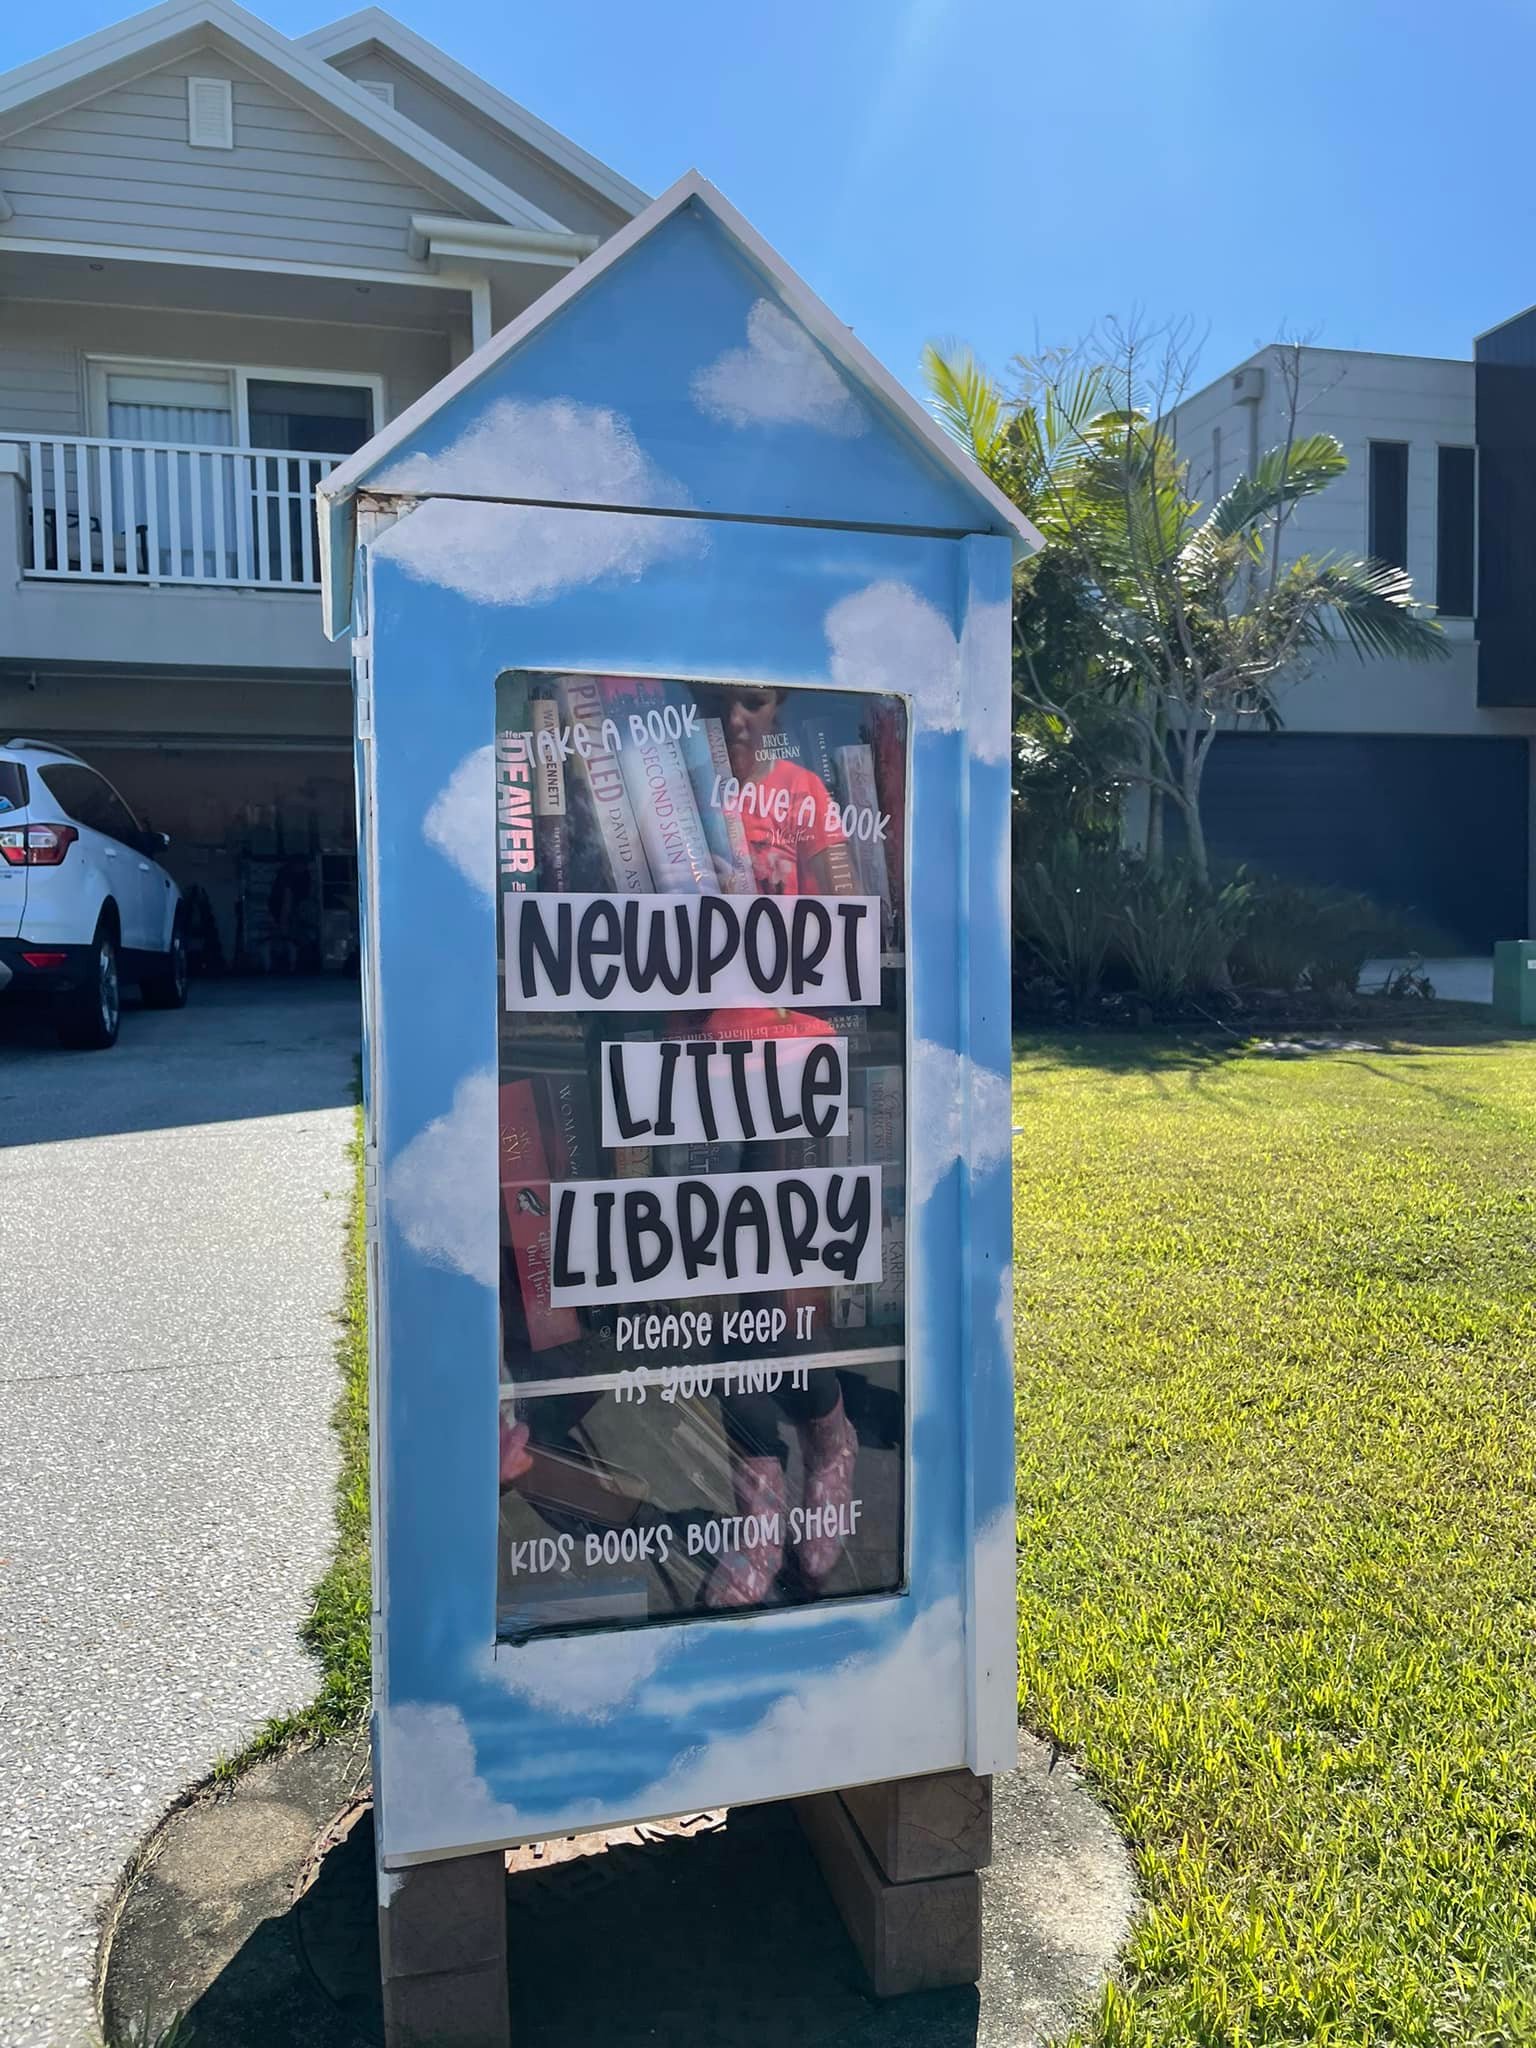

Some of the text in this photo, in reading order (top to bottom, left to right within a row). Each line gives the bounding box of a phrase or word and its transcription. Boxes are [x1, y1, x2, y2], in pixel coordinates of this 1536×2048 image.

[520, 703, 700, 768] TAKE A BOOK
[542, 709, 557, 751] WAY
[754, 745, 801, 762] COURTENAY
[761, 732, 790, 748] BRYCE
[497, 738, 536, 873] DEAVER
[640, 746, 687, 865] SECOND SKIN
[710, 774, 790, 822] LEAVE
[797, 795, 816, 828] A
[824, 800, 891, 843] BOOK
[609, 807, 643, 893] DAVID AS
[519, 896, 867, 1002] NEWPORT
[609, 1040, 842, 1141] LITTLE
[553, 1174, 871, 1288] LIBRARY
[615, 1306, 816, 1351] PLEASE KEEP IT
[614, 1360, 811, 1404] AS YOU FIND IT
[511, 1500, 862, 1576] KIDS BOOKS BOTTOM SHELF
